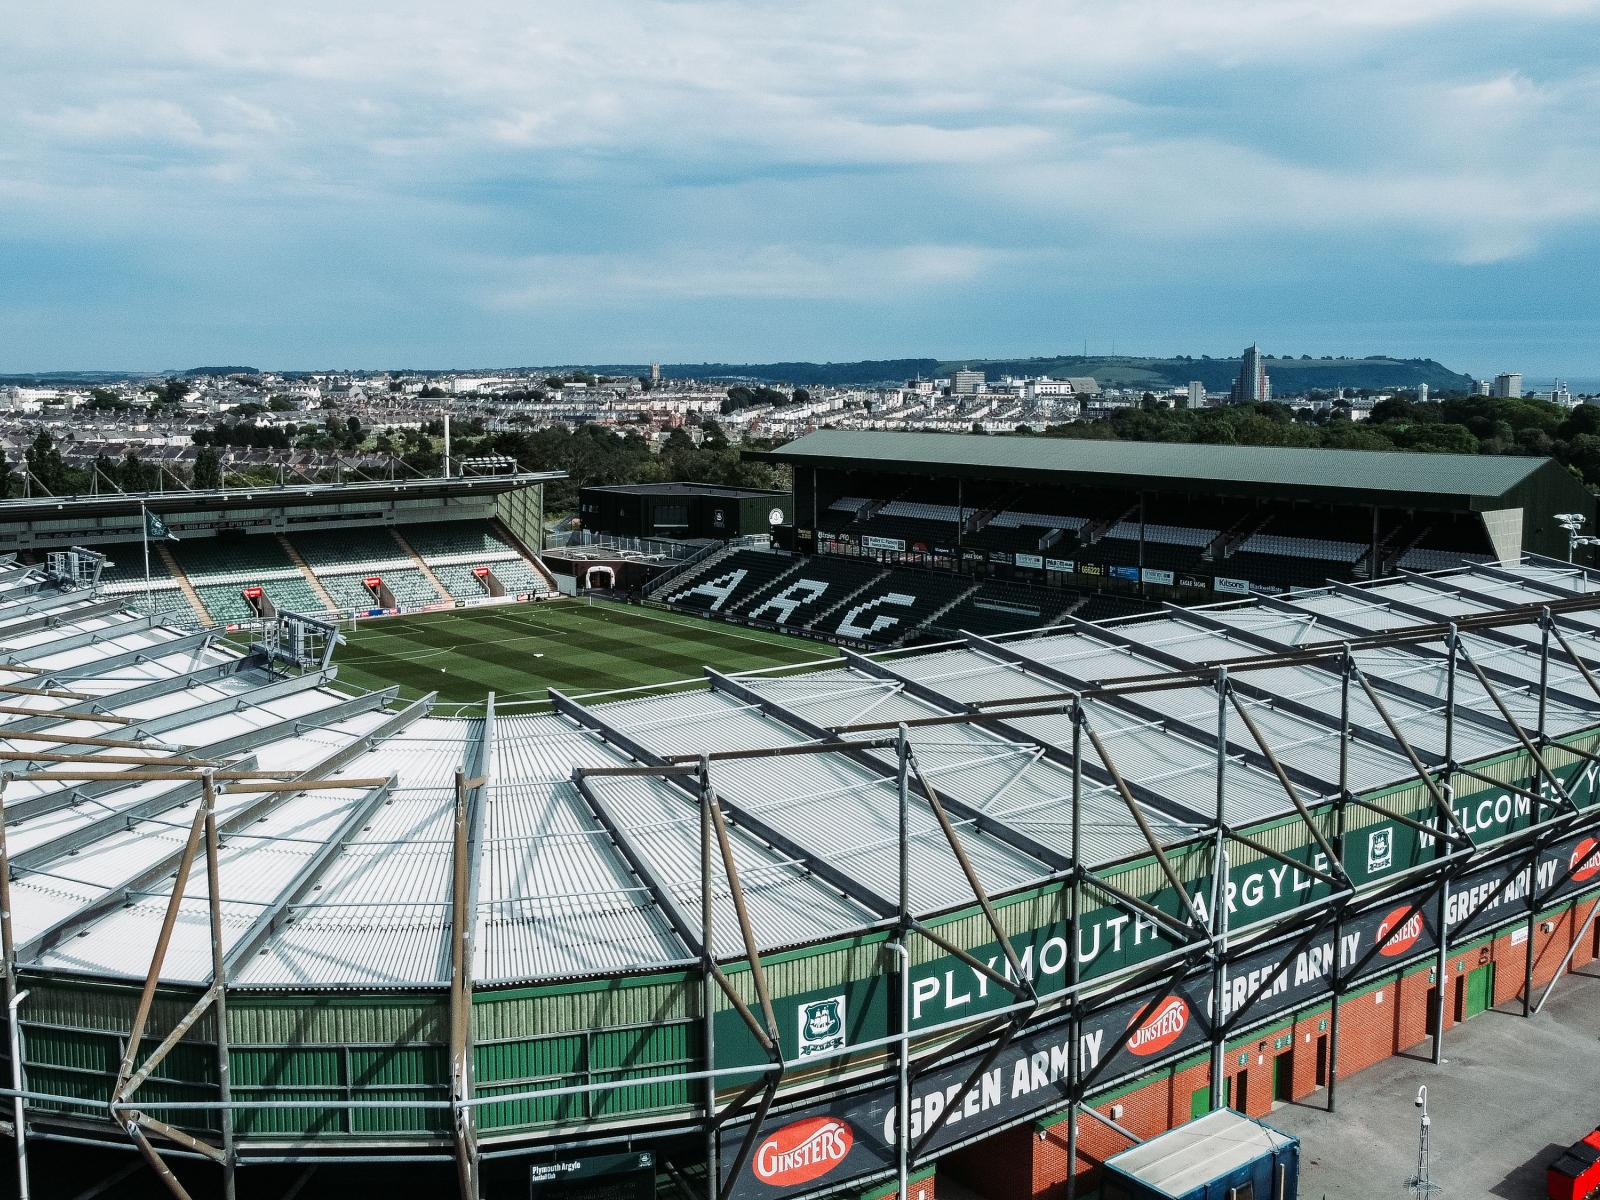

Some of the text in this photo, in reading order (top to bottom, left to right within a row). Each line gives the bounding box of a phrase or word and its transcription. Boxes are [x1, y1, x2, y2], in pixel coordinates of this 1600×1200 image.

[1419, 765, 1600, 849] WELCOMES Y
[1448, 858, 1558, 925] GREEN ARMY
[911, 851, 1332, 1020] PLYMOUTH ARGYLE
[1207, 932, 1361, 1018] GREEN ARMY
[883, 1029, 1104, 1144] GREEN ARMY
[532, 1161, 581, 1175] Plymouth Argyle
